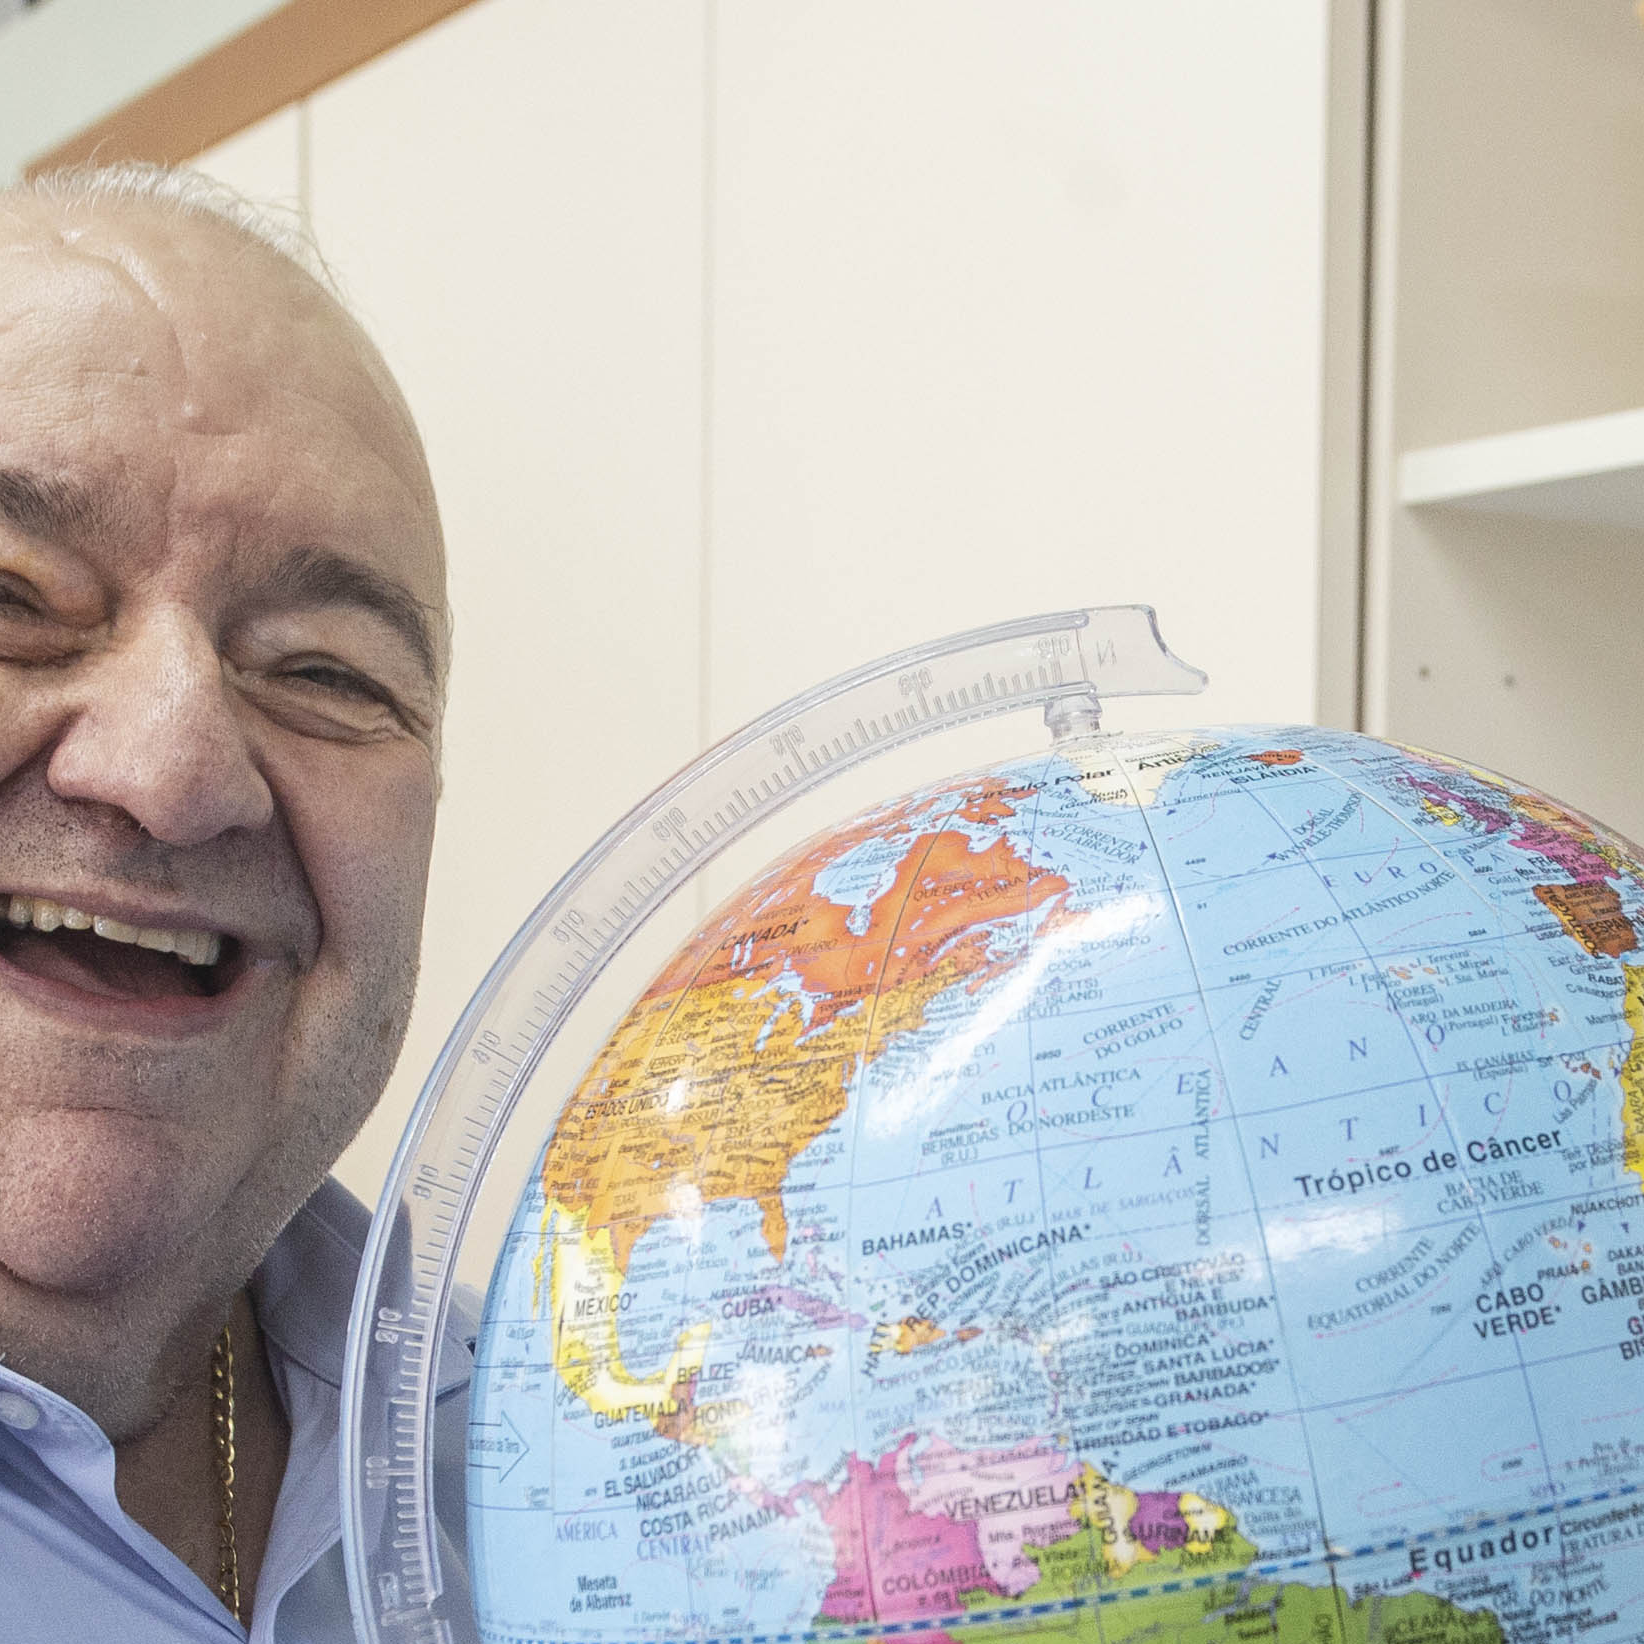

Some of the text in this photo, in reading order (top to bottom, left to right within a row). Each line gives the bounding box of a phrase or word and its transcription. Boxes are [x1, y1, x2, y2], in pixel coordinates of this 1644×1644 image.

[1054, 767, 1115, 785] Polar
[1223, 925, 1310, 957] CORRENTE
[1083, 1002, 1175, 1046] CORRENTE
[1096, 1018, 1183, 1060] DO GOLFO
[981, 1067, 1141, 1105] BACIA ATLÂNTICA
[1038, 1105, 1135, 1130] NORDESTE
[922, 1128, 999, 1155] BERMUDAS
[1294, 1129, 1563, 1200] Trópico de Câncer
[1475, 1283, 1544, 1313] CABO
[1409, 1525, 1555, 1573] Equador
